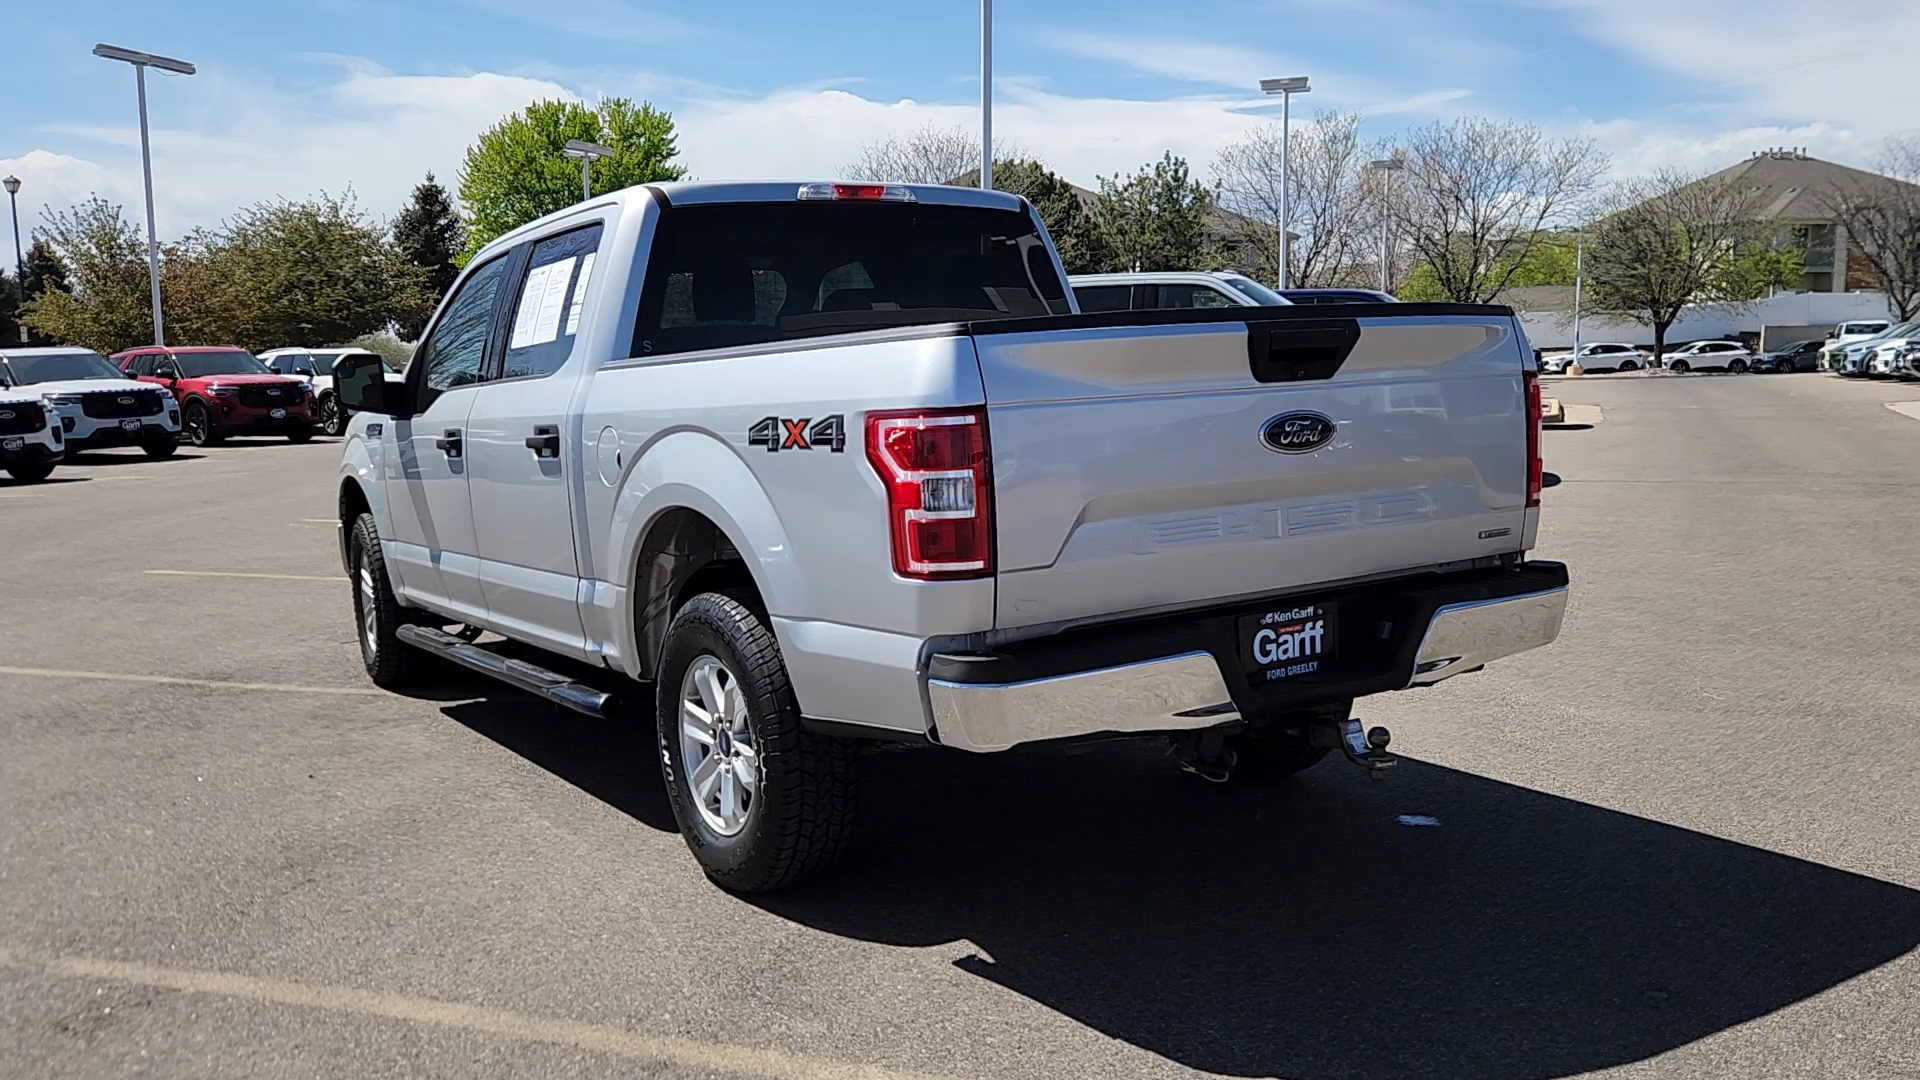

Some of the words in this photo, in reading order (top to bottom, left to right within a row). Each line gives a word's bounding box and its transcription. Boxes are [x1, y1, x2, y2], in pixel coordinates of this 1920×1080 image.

[643, 340, 653, 353] S
[1280, 420, 1322, 444] Ford
[1273, 612, 1291, 622] Ken
[1292, 605, 1314, 619] Garff
[1253, 620, 1324, 664] Garff
[1266, 667, 1286, 680] FORD
[1287, 661, 1318, 676] GREELEY
